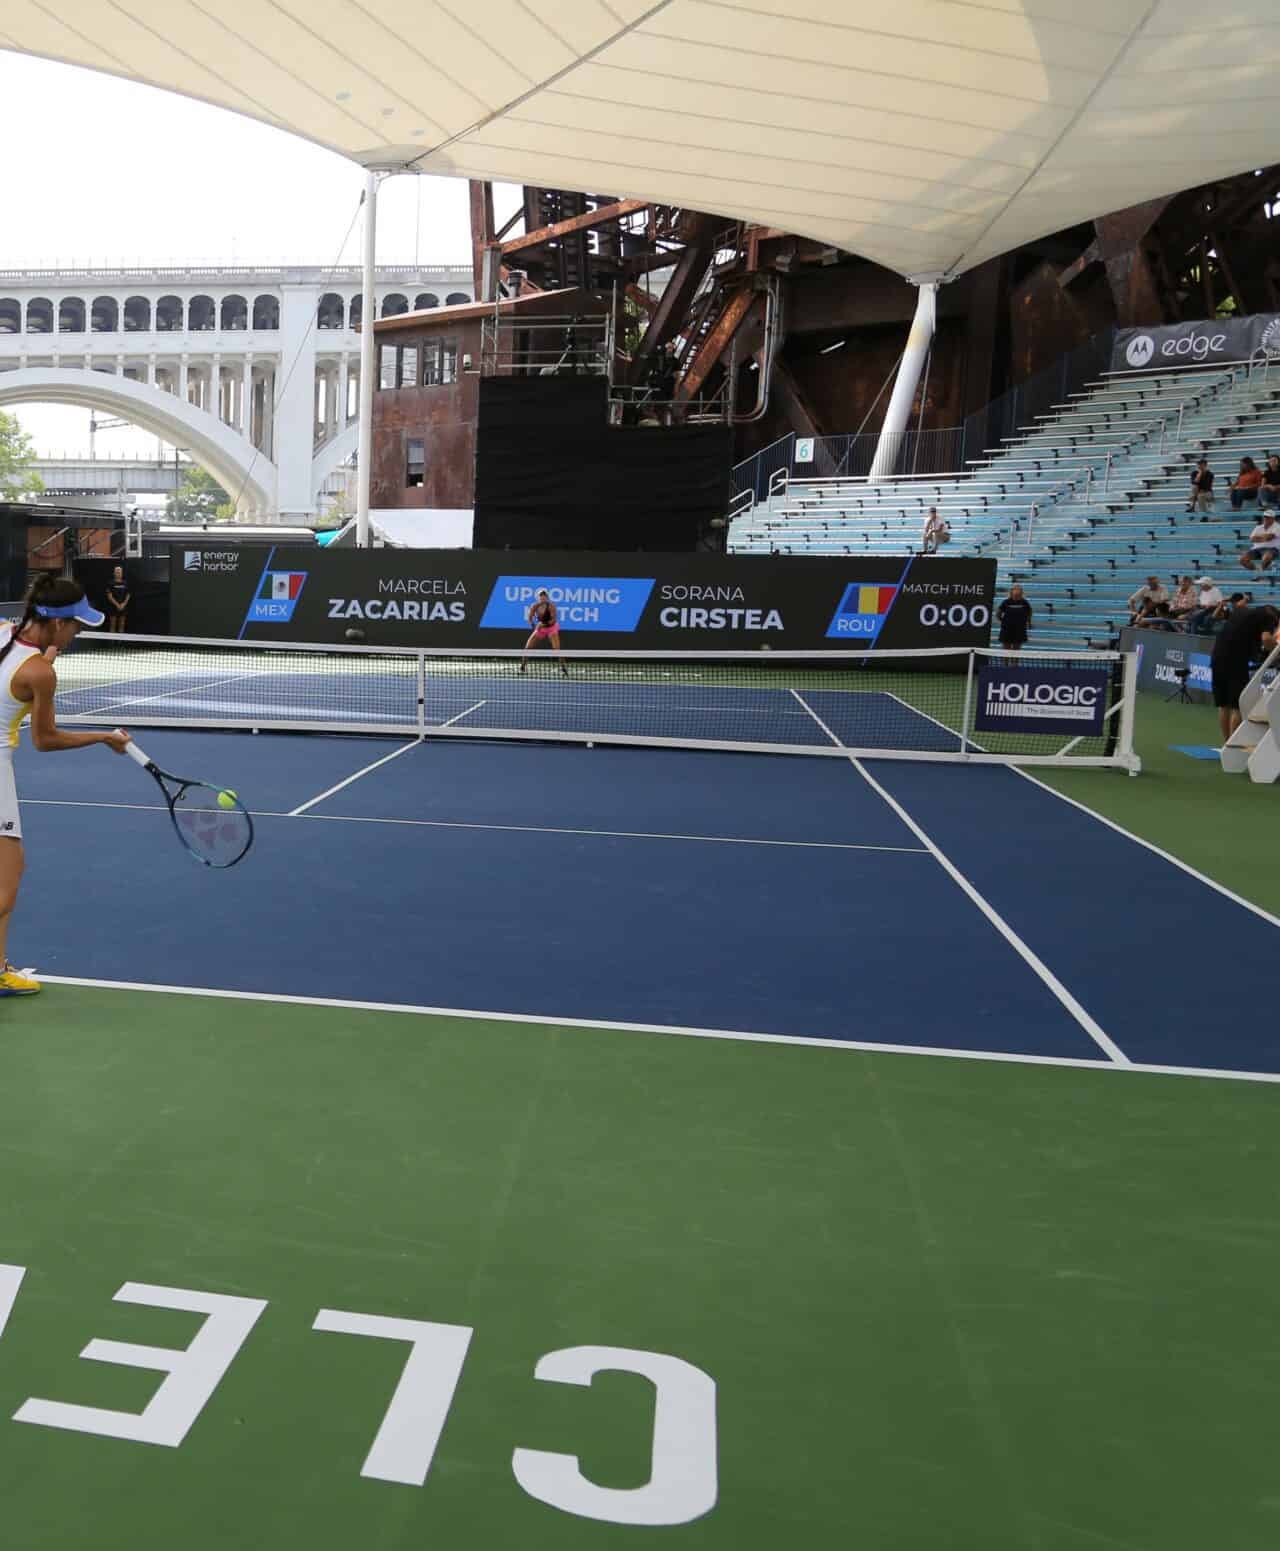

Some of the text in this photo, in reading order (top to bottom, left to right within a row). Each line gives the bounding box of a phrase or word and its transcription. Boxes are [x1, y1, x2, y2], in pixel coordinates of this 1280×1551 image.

[1161, 331, 1227, 361] edge
[799, 442, 809, 458] 6
[203, 551, 239, 562] energy
[203, 560, 239, 571] harbor
[378, 579, 467, 595] MARCELA
[660, 585, 745, 601] SORANA
[902, 583, 985, 595] MATCH TIME
[255, 604, 288, 617] MEX
[327, 599, 466, 621] ZACARIAS
[523, 607, 599, 623] TCH
[920, 604, 989, 627] 0:00
[660, 607, 785, 630] CIRSTEA
[837, 619, 876, 632] ROU
[987, 682, 1097, 705] HOLOGIC
